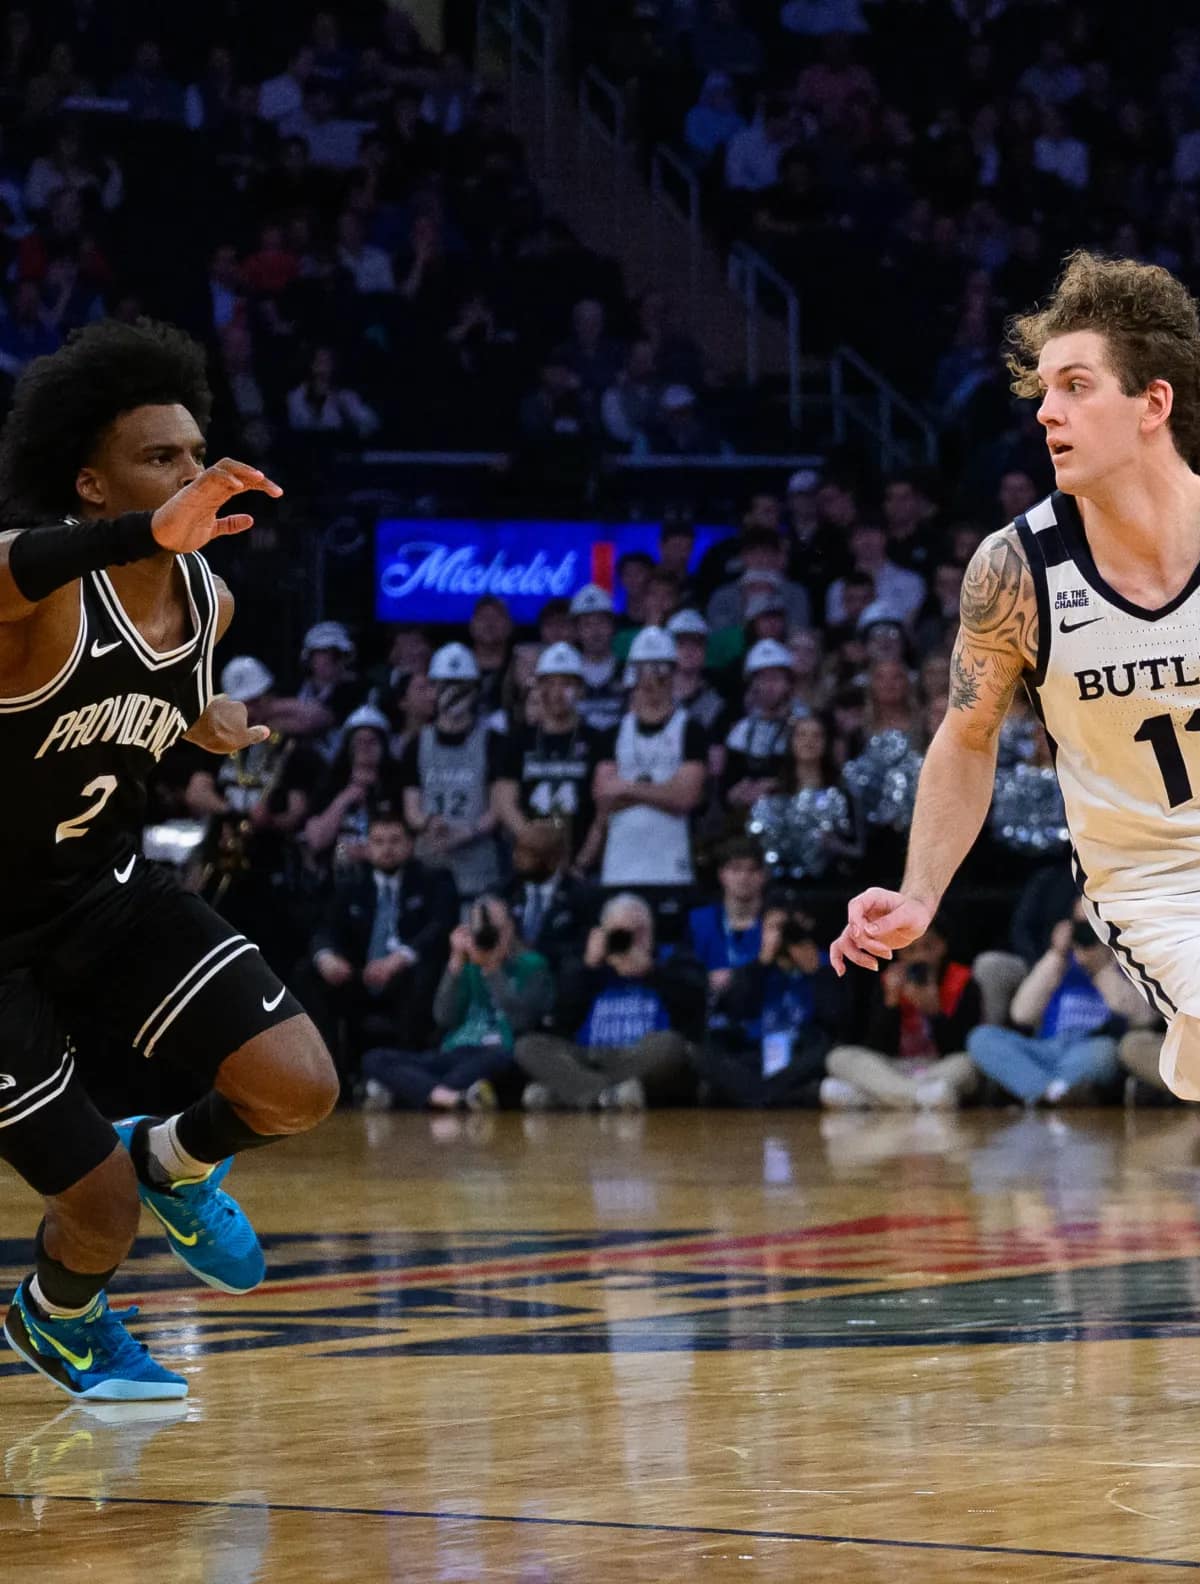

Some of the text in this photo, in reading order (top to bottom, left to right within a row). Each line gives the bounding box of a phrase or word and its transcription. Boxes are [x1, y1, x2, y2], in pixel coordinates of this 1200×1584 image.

[380, 541, 578, 598] Michelob
[1055, 597, 1089, 609] CHANGE
[1056, 588, 1087, 601] BE THE
[55, 774, 118, 844] 2
[528, 780, 578, 817] 44
